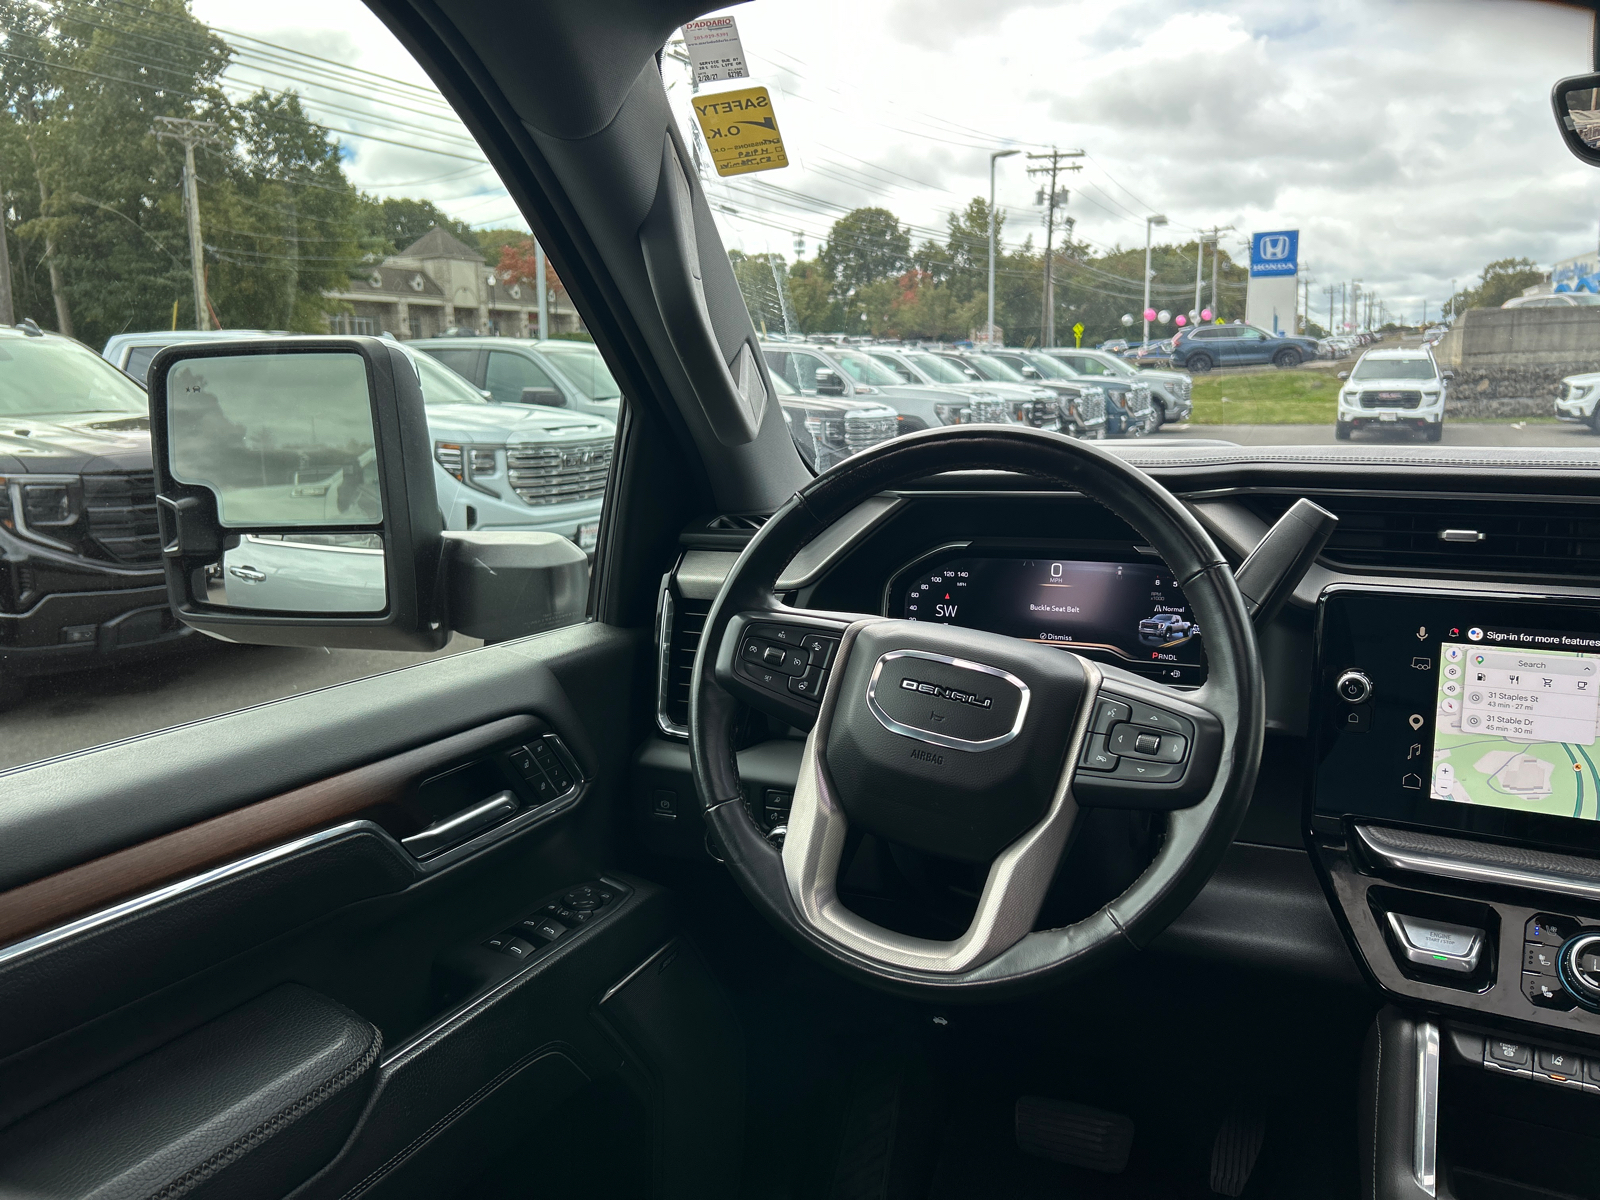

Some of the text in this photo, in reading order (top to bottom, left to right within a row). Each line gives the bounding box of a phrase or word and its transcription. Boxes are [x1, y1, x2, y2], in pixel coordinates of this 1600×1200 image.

[686, 18, 731, 30] D'ADDARIO
[1252, 261, 1295, 272] HONDA
[1050, 562, 1063, 577] 0
[935, 604, 958, 618] SW
[1029, 603, 1050, 612] Buckle
[1067, 605, 1080, 613] Belt
[1162, 605, 1185, 613] Normal
[1047, 633, 1073, 641] Dismiss
[1486, 631, 1600, 647] Sign-in for more features
[1518, 659, 1546, 669] Search
[901, 679, 992, 709] DENALI
[1488, 691, 1539, 703] 31 Staples St
[1497, 701, 1511, 709] min
[1486, 714, 1534, 726] 31 Stable Dr
[1524, 727, 1533, 735] mi
[910, 748, 944, 766] AIRBAG
[1429, 931, 1452, 941] ENGINE
